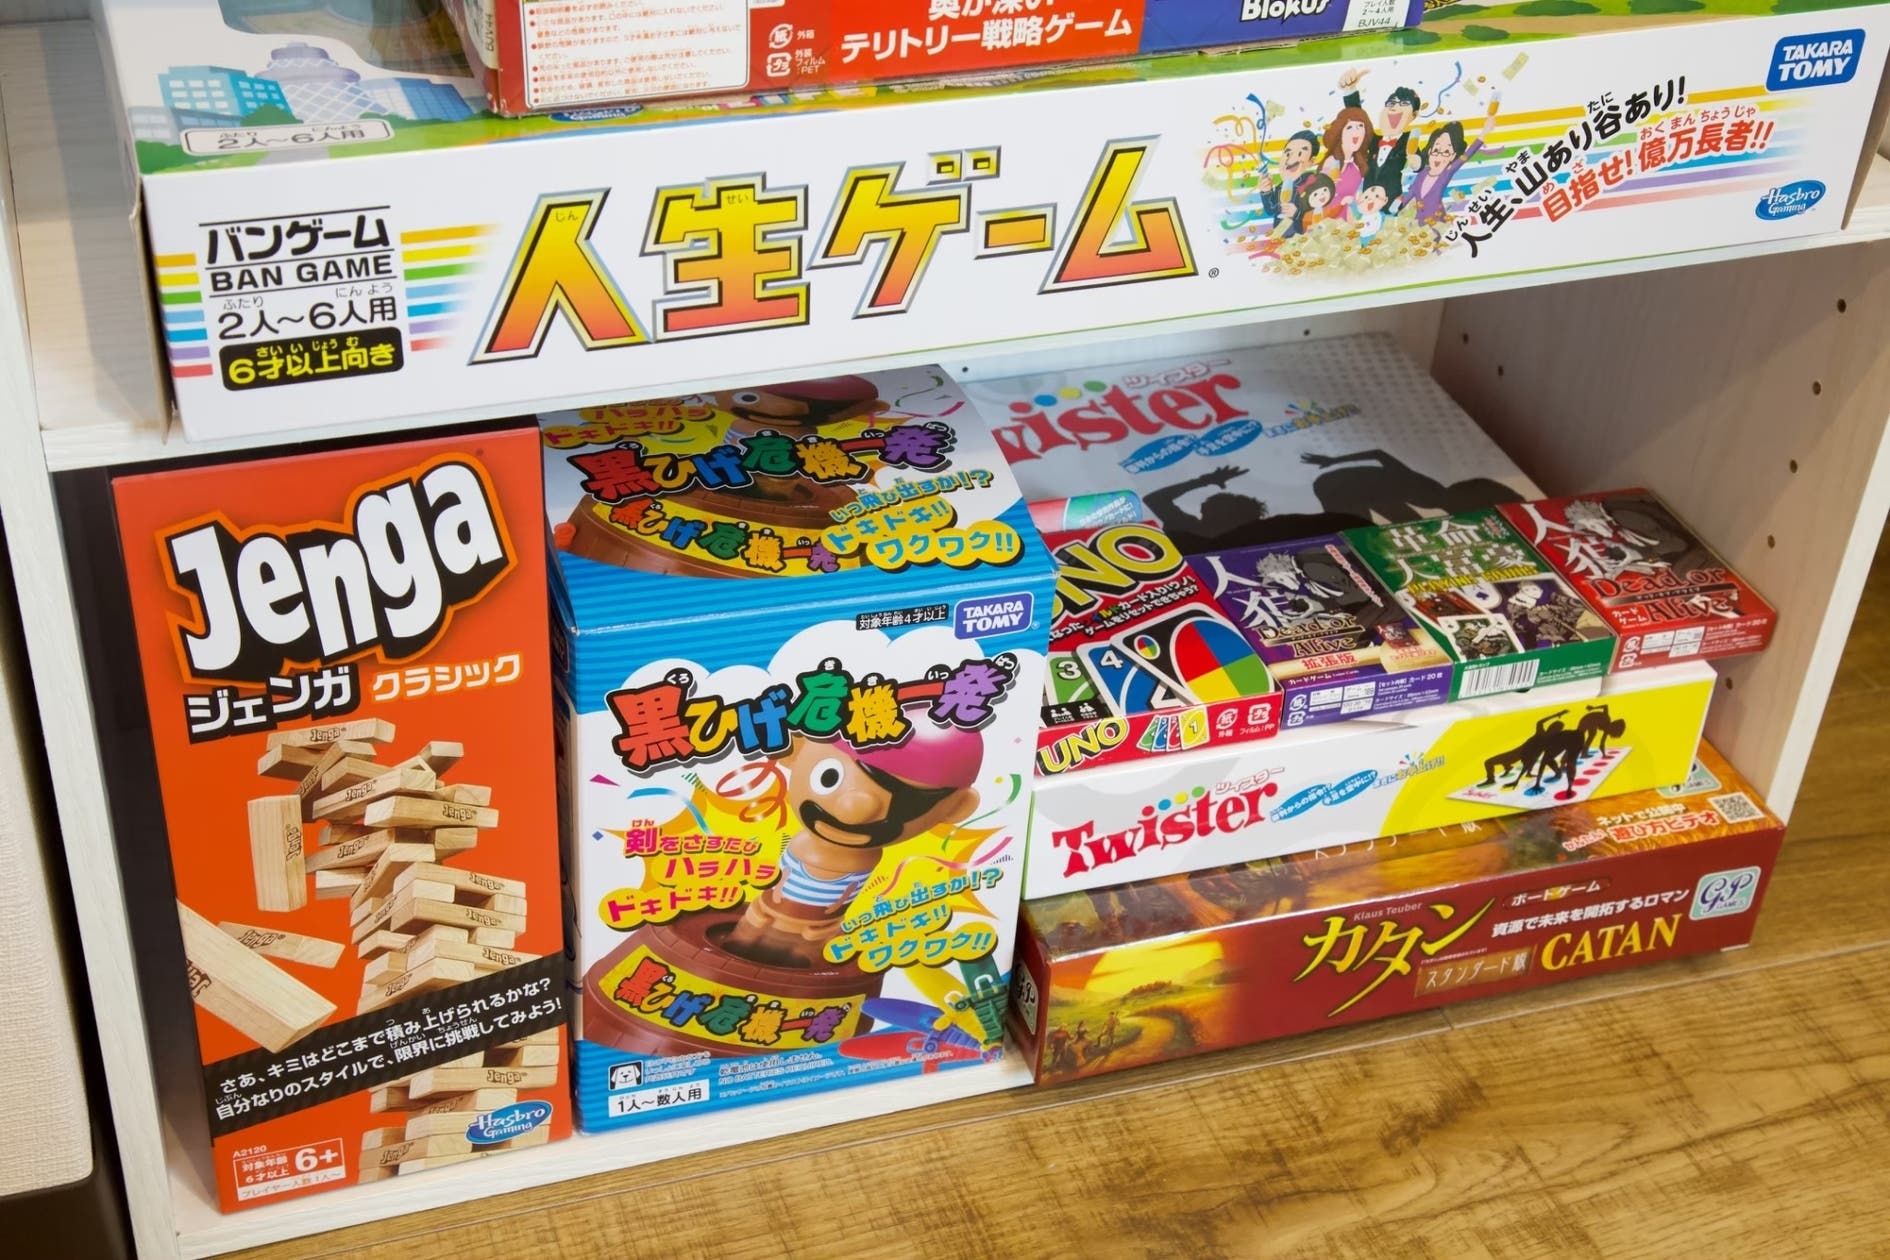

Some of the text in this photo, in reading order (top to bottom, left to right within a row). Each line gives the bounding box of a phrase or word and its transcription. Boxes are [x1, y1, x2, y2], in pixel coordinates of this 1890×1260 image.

[841, 9, 1133, 63] テリトリー戦略ゲーム
[1783, 39, 1854, 62] TAKARA
[1778, 57, 1850, 82] TOMY
[1762, 187, 1820, 207] Hasbro
[1768, 201, 1807, 216] Gaming
[207, 215, 391, 264] バンゲーム
[468, 134, 1200, 366] 人生ゲーム
[211, 254, 393, 292] BAN GAME
[228, 343, 396, 385] 6才以上向き
[991, 373, 1249, 465] wister
[572, 424, 951, 500] 黒ひげ危機一発
[610, 499, 839, 572] 黒ひげ危機一発
[875, 530, 1014, 563] ワクワク!!
[170, 463, 503, 671] Jenga
[1052, 524, 1184, 622] NO
[1586, 566, 1727, 599] Dead or
[962, 612, 1023, 633] TOMY
[963, 600, 1025, 618] TAKARA
[1644, 596, 1732, 623] Alive
[1257, 614, 1358, 640] Dead or
[1100, 649, 1124, 669] 4
[1294, 636, 1356, 658] Alive
[1302, 652, 1358, 670] 拡張版
[372, 652, 521, 702] クラシック
[1058, 660, 1082, 680] 3
[187, 665, 350, 734] ジェンガ
[612, 660, 1010, 767] 黒ひげ危機一発
[309, 727, 341, 743] Jenga
[1038, 716, 1129, 773] UNO
[1215, 767, 1285, 795] ツイスター
[442, 804, 474, 821] Jenga
[1608, 811, 1720, 842] 遊び方ビデオ
[625, 828, 763, 857] 剣をさすたび
[1051, 782, 1278, 878] Twister
[665, 857, 780, 882] ハラハラ
[606, 886, 741, 923] ドキドキ!!
[842, 867, 1003, 933] いつ飛び出すか!?
[1511, 879, 1601, 907] ボードゲーム
[1354, 902, 1423, 922] Klaus Teuber
[1491, 889, 1690, 938] 資源で未来を開拓するロマン
[830, 906, 949, 961] ドキドキ!!
[868, 932, 993, 966] ワクワク!!
[1541, 913, 1683, 971] CATAN
[1294, 897, 1496, 1018] カタン
[1425, 951, 1529, 989] スタンダード版
[613, 956, 846, 1047] 黒ひげ危機一発
[220, 977, 551, 1094] さあ、キミはどこまで積み上げられるかな?
[215, 997, 562, 1121] 自分なりのスタイルで、限界に挑戦してみよう!
[486, 1068, 523, 1084] Jenga
[477, 1105, 546, 1131] Hasbro
[484, 1121, 533, 1139] Gaming
[233, 1144, 267, 1158] A2120
[294, 1147, 338, 1172] 6+
